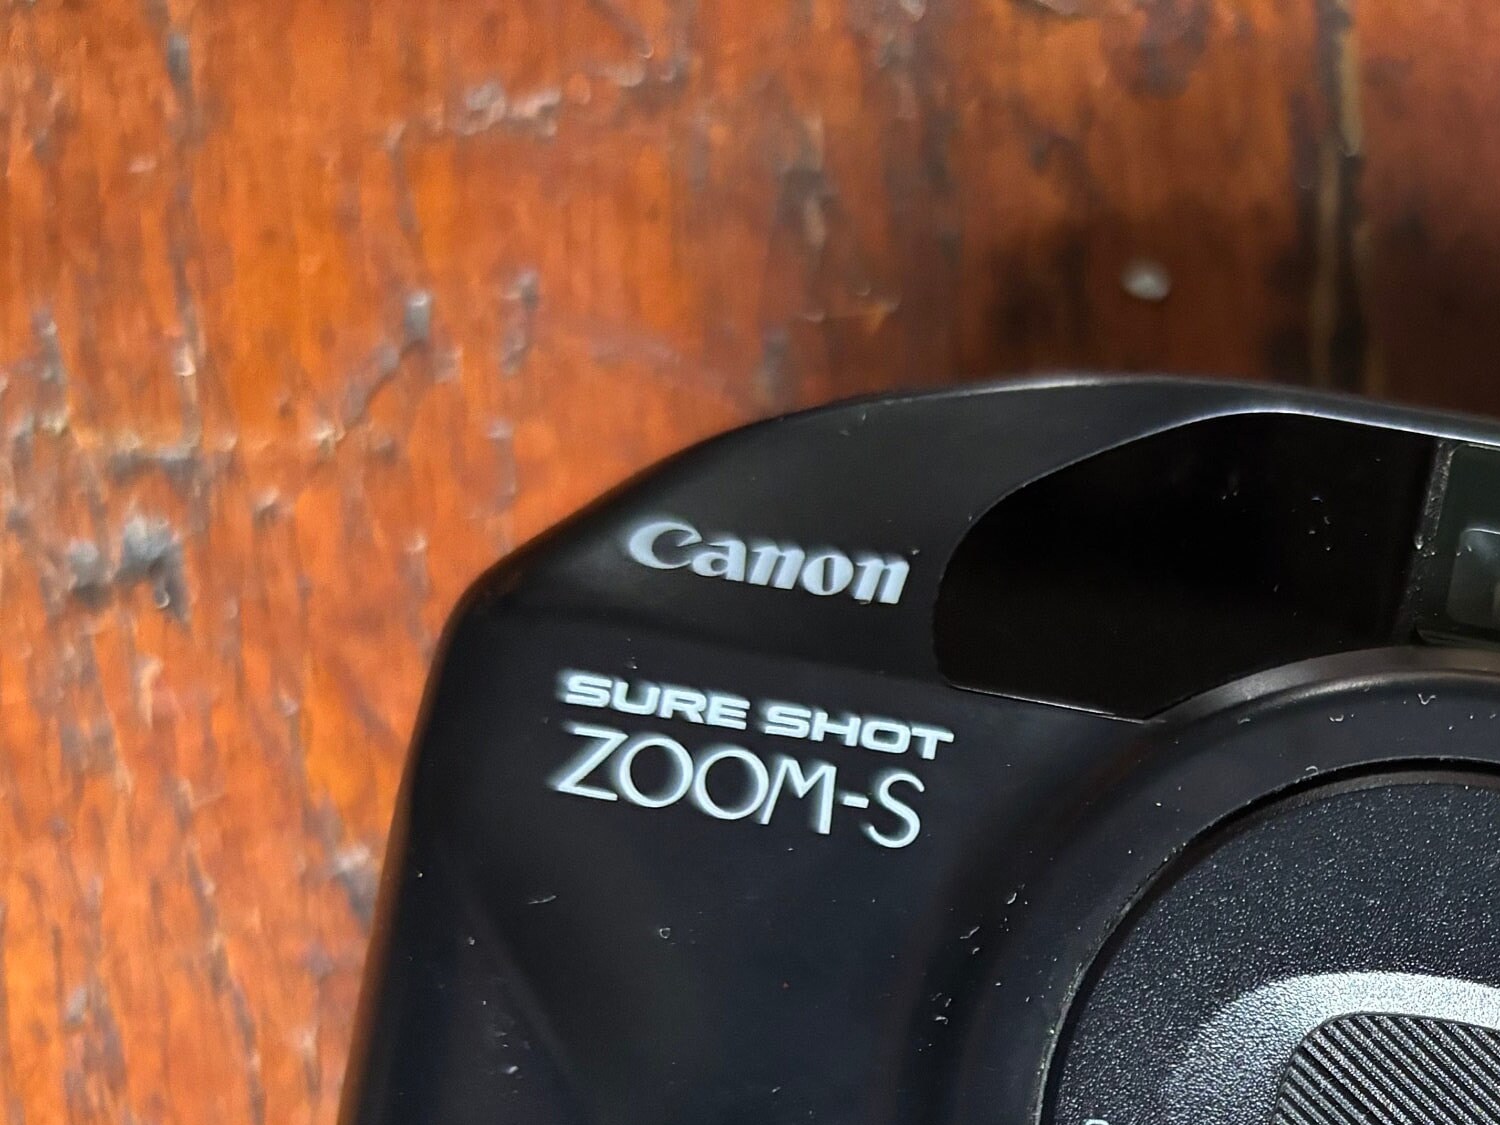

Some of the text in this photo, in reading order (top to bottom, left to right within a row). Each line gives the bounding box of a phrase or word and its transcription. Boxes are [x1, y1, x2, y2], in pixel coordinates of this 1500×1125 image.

[627, 520, 911, 605] Canon
[563, 673, 955, 760] SURE SHOT
[555, 726, 926, 849] ZOOM-S
